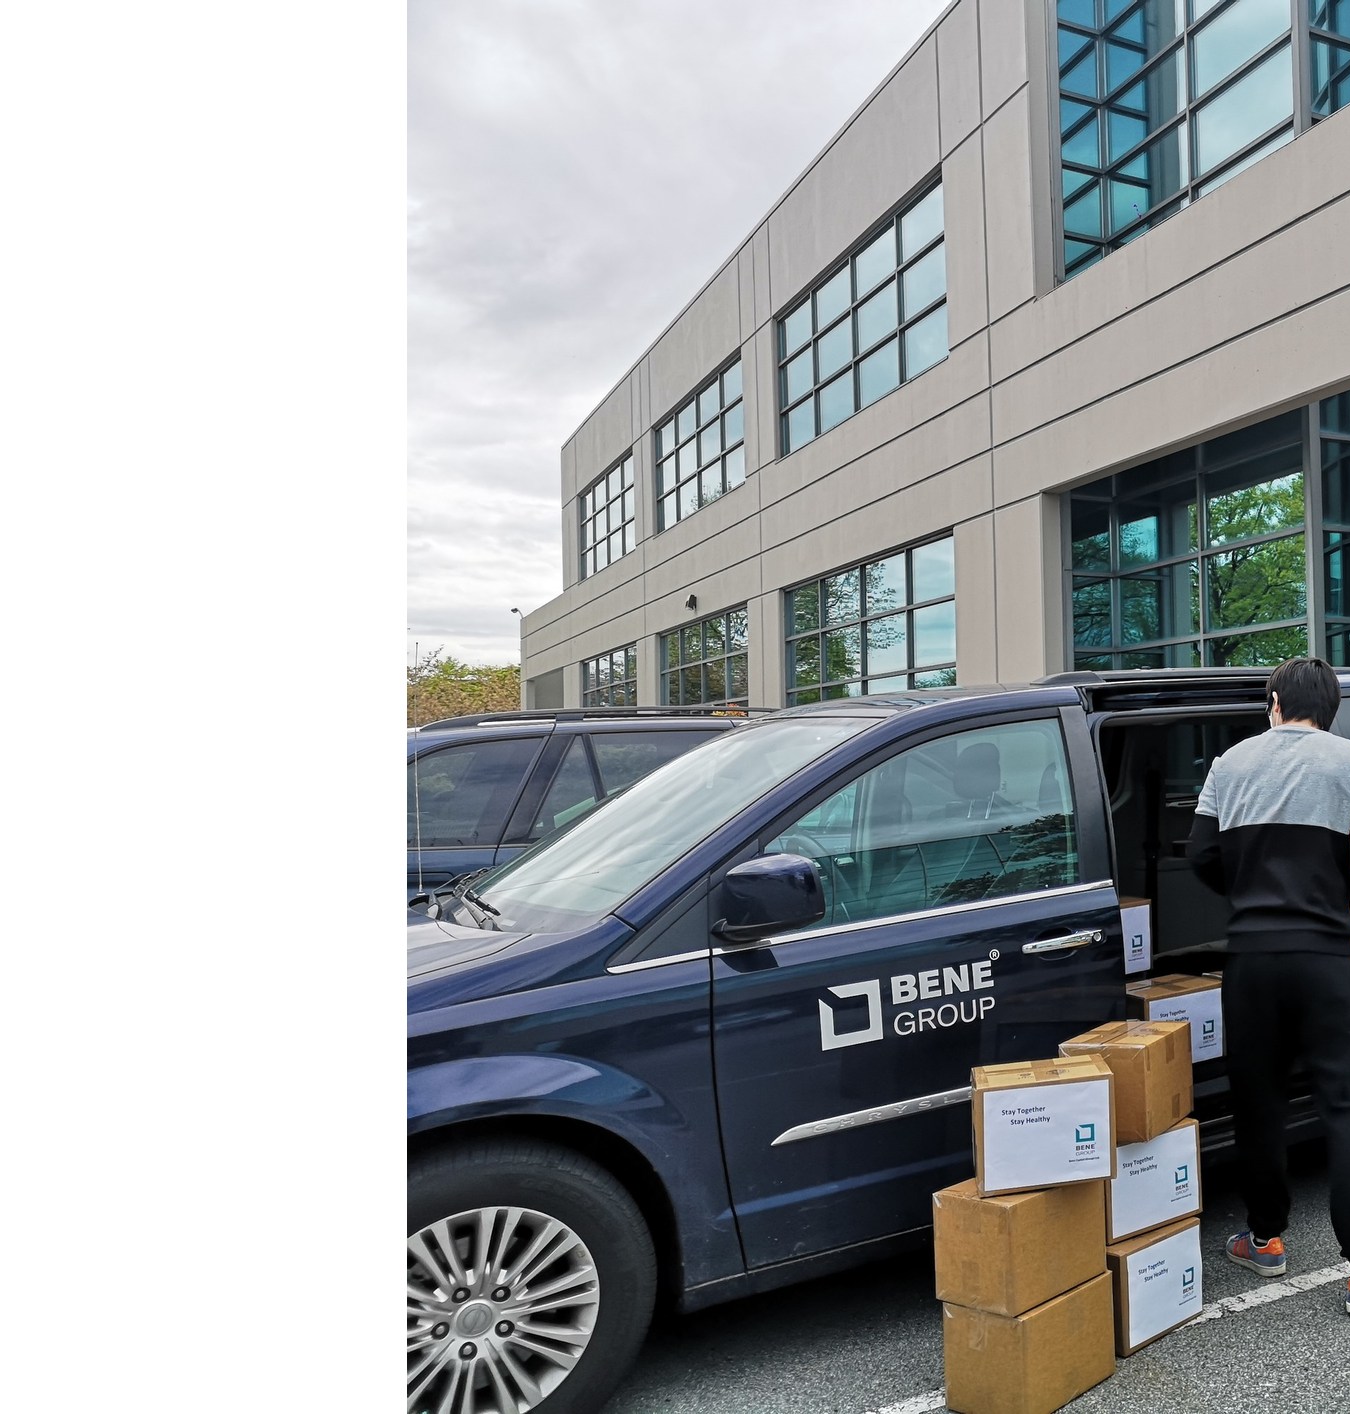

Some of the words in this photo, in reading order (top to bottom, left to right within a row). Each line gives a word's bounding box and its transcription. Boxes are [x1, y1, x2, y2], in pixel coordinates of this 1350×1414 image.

[893, 996, 996, 1036] GROUP
[1169, 1009, 1186, 1017] Together
[1001, 1108, 1016, 1117] Stay
[1017, 1106, 1046, 1115] Together
[1026, 1116, 1051, 1124] Healthy
[1133, 1156, 1154, 1165] Together
[1140, 1163, 1158, 1173] Healthy
[1147, 1260, 1166, 1270] Together
[1153, 1268, 1169, 1278] Healthy
